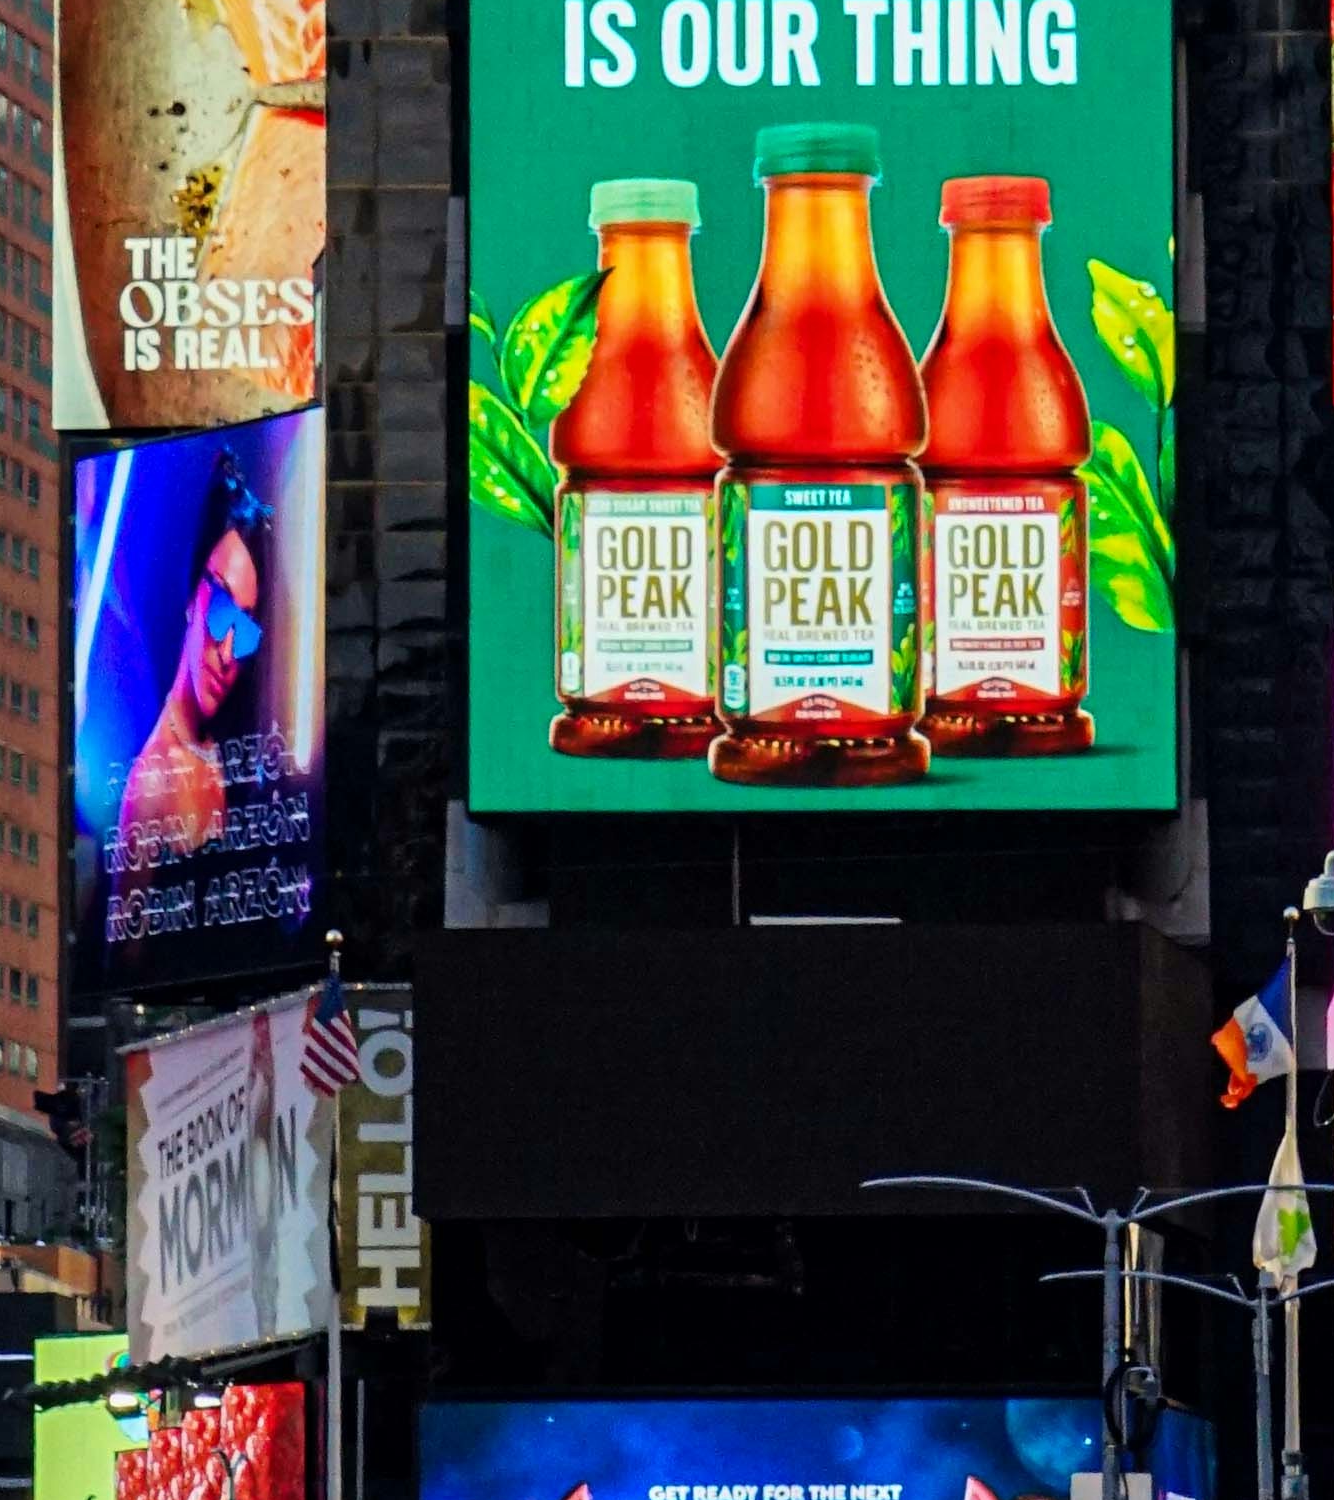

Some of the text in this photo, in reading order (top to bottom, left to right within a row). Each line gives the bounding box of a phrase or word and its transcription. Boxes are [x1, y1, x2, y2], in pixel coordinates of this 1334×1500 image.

[124, 238, 197, 279] THE
[124, 328, 279, 371] IS REAL.
[785, 489, 852, 506] SWEET TEA
[597, 526, 692, 571] GOLD
[763, 520, 874, 572] GOLD
[948, 524, 1045, 570] GOLD
[597, 575, 693, 618] PEAK
[763, 577, 873, 627] PEAK
[948, 573, 1044, 618] PEAK
[157, 1128, 183, 1179] THE
